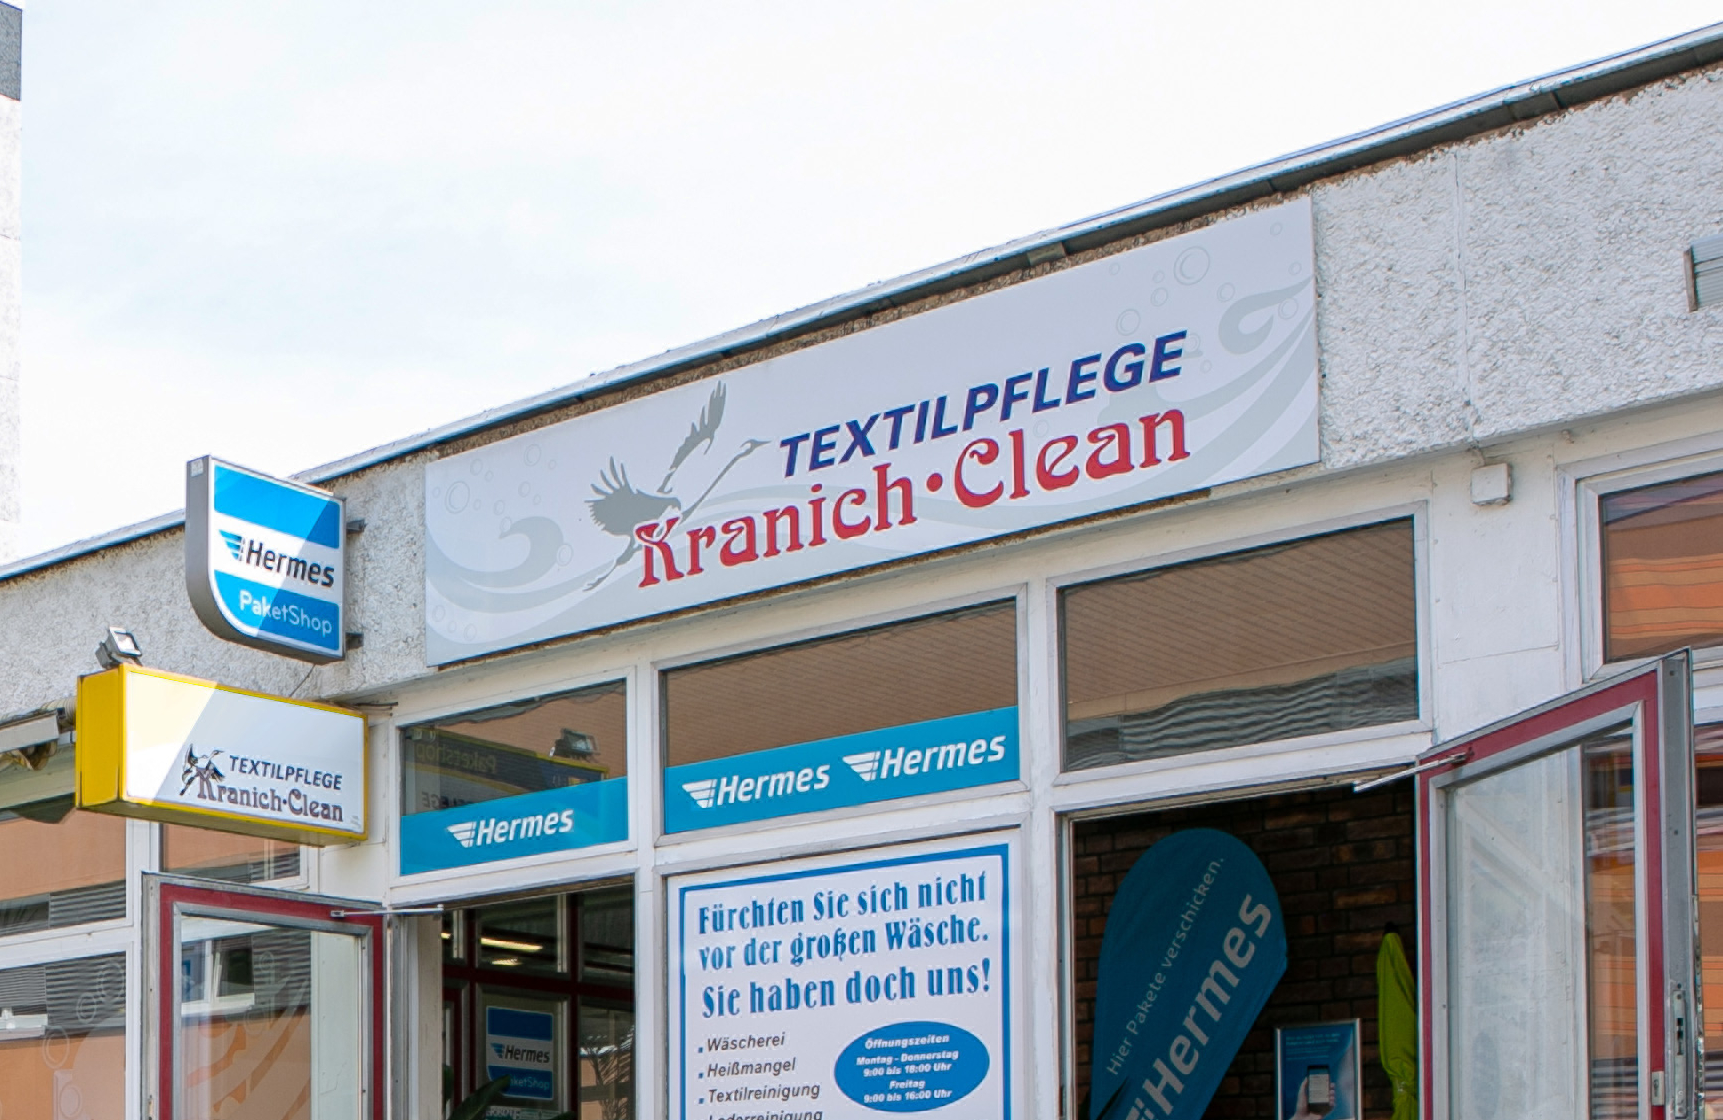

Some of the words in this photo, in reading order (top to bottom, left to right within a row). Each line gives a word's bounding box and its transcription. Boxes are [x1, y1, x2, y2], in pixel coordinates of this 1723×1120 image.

[778, 330, 1188, 478] TEXTILPFLEGE
[245, 539, 335, 588] Hermes
[239, 589, 333, 638] PaketShop
[229, 754, 343, 791] TEXTILPFLEGE
[881, 735, 1007, 780] Hermes
[717, 763, 831, 806] Hermes
[476, 809, 575, 846] Hermes
[698, 897, 804, 935] Fürchten
[813, 890, 849, 921] Sie
[857, 881, 908, 916] sich
[917, 870, 986, 909] nicht
[698, 944, 736, 971] vor
[743, 937, 782, 966] der
[789, 927, 876, 967] großen
[885, 914, 989, 950] Wäsche.
[1106, 1036, 1133, 1076] Hier
[1126, 971, 1166, 1035] Pakete
[1161, 856, 1225, 970] verschicken.
[702, 984, 741, 1019] Sie
[749, 976, 835, 1014] haben
[845, 965, 915, 1004] doch
[927, 957, 991, 997] uns!
[1141, 893, 1272, 1116] Hermes
[505, 1044, 550, 1064] Hermes
[707, 1031, 786, 1052] Wäscherei
[856, 1055, 894, 1066] Montag
[900, 1049, 960, 1063] Donnerstag
[864, 1034, 950, 1050] Öffnungszeiten
[707, 1057, 797, 1078] Heißmangel
[863, 1067, 884, 1077] 9:00
[886, 1066, 902, 1075] bis
[904, 1063, 932, 1074] 18:00
[933, 1062, 953, 1072] Uhr
[889, 1080, 926, 1090] Freitag
[708, 1084, 821, 1104] Textilreinigung
[863, 1093, 885, 1104] 9:00
[886, 1092, 902, 1102] bis
[904, 1090, 932, 1101] 16:00
[933, 1089, 953, 1099] Uhr
